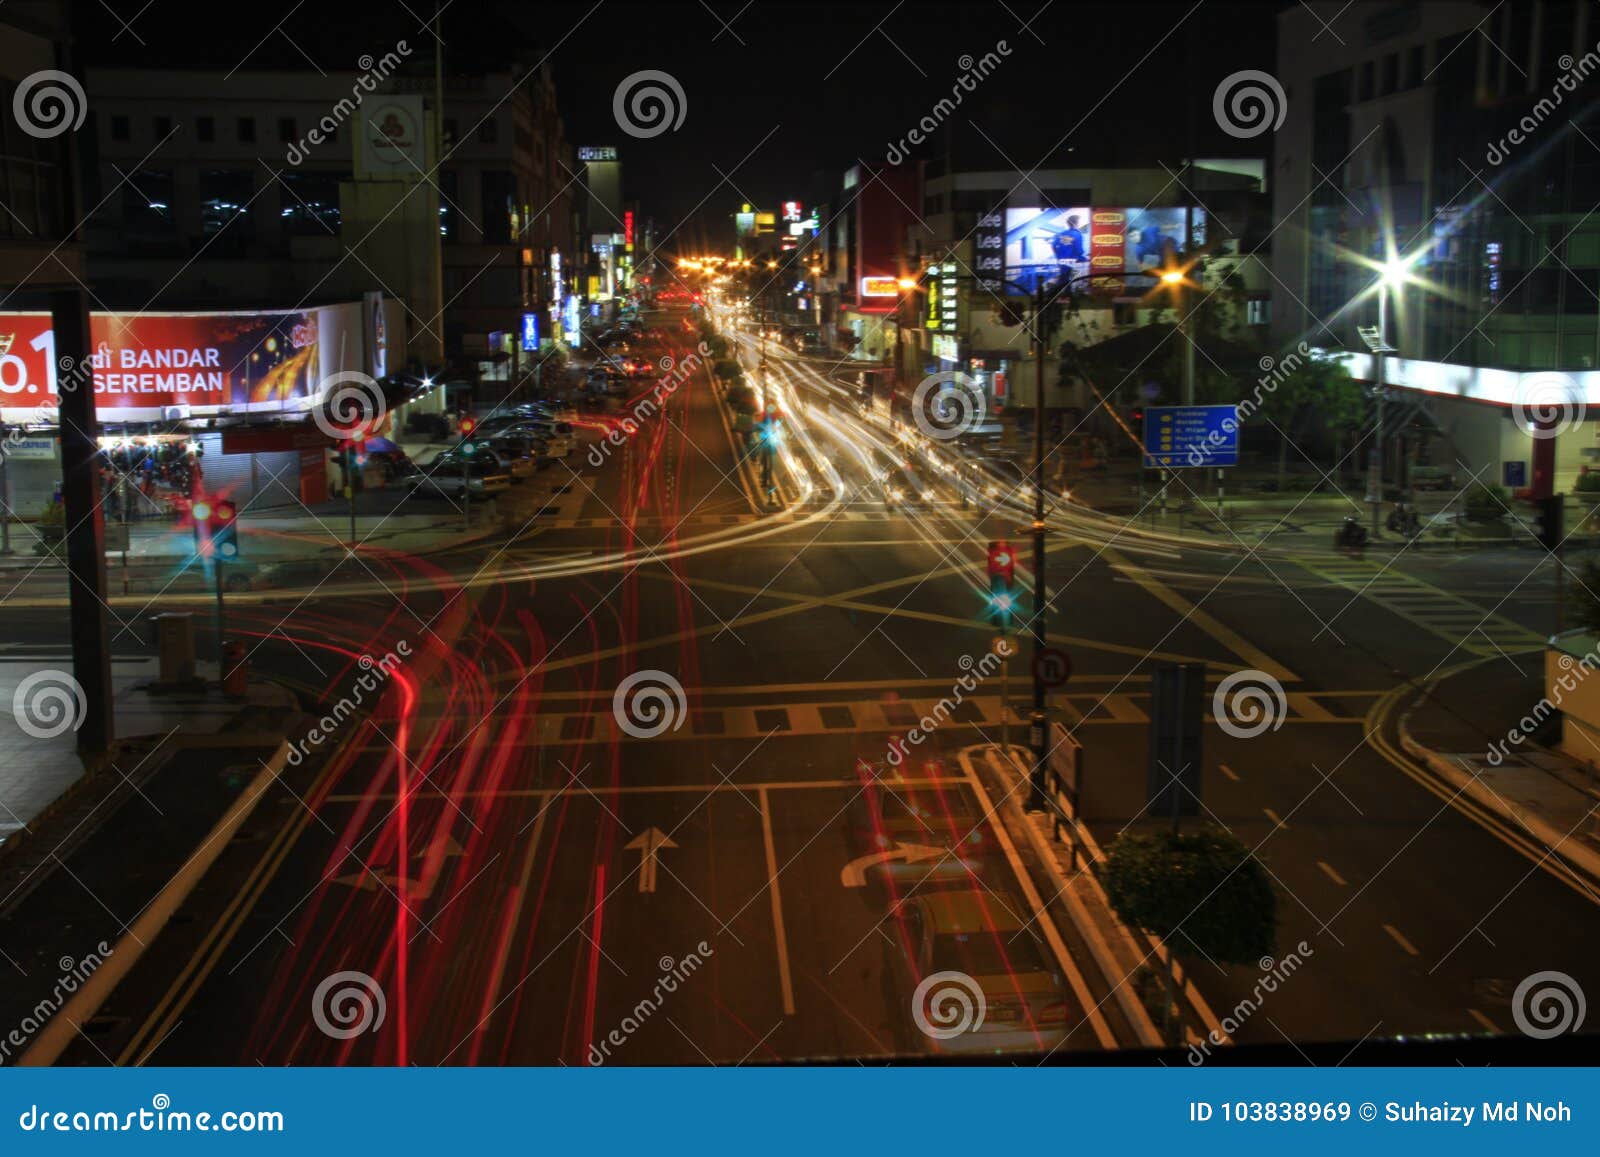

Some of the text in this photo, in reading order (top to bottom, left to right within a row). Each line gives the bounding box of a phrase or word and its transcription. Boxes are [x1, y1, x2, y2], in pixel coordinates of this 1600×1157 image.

[578, 147, 617, 160] HOTEL
[976, 212, 1002, 227] Lee
[976, 233, 1002, 248] Lee
[976, 255, 1002, 270] Lee
[92, 348, 220, 369] di BANDAR
[93, 372, 223, 393] SEREMBAN
